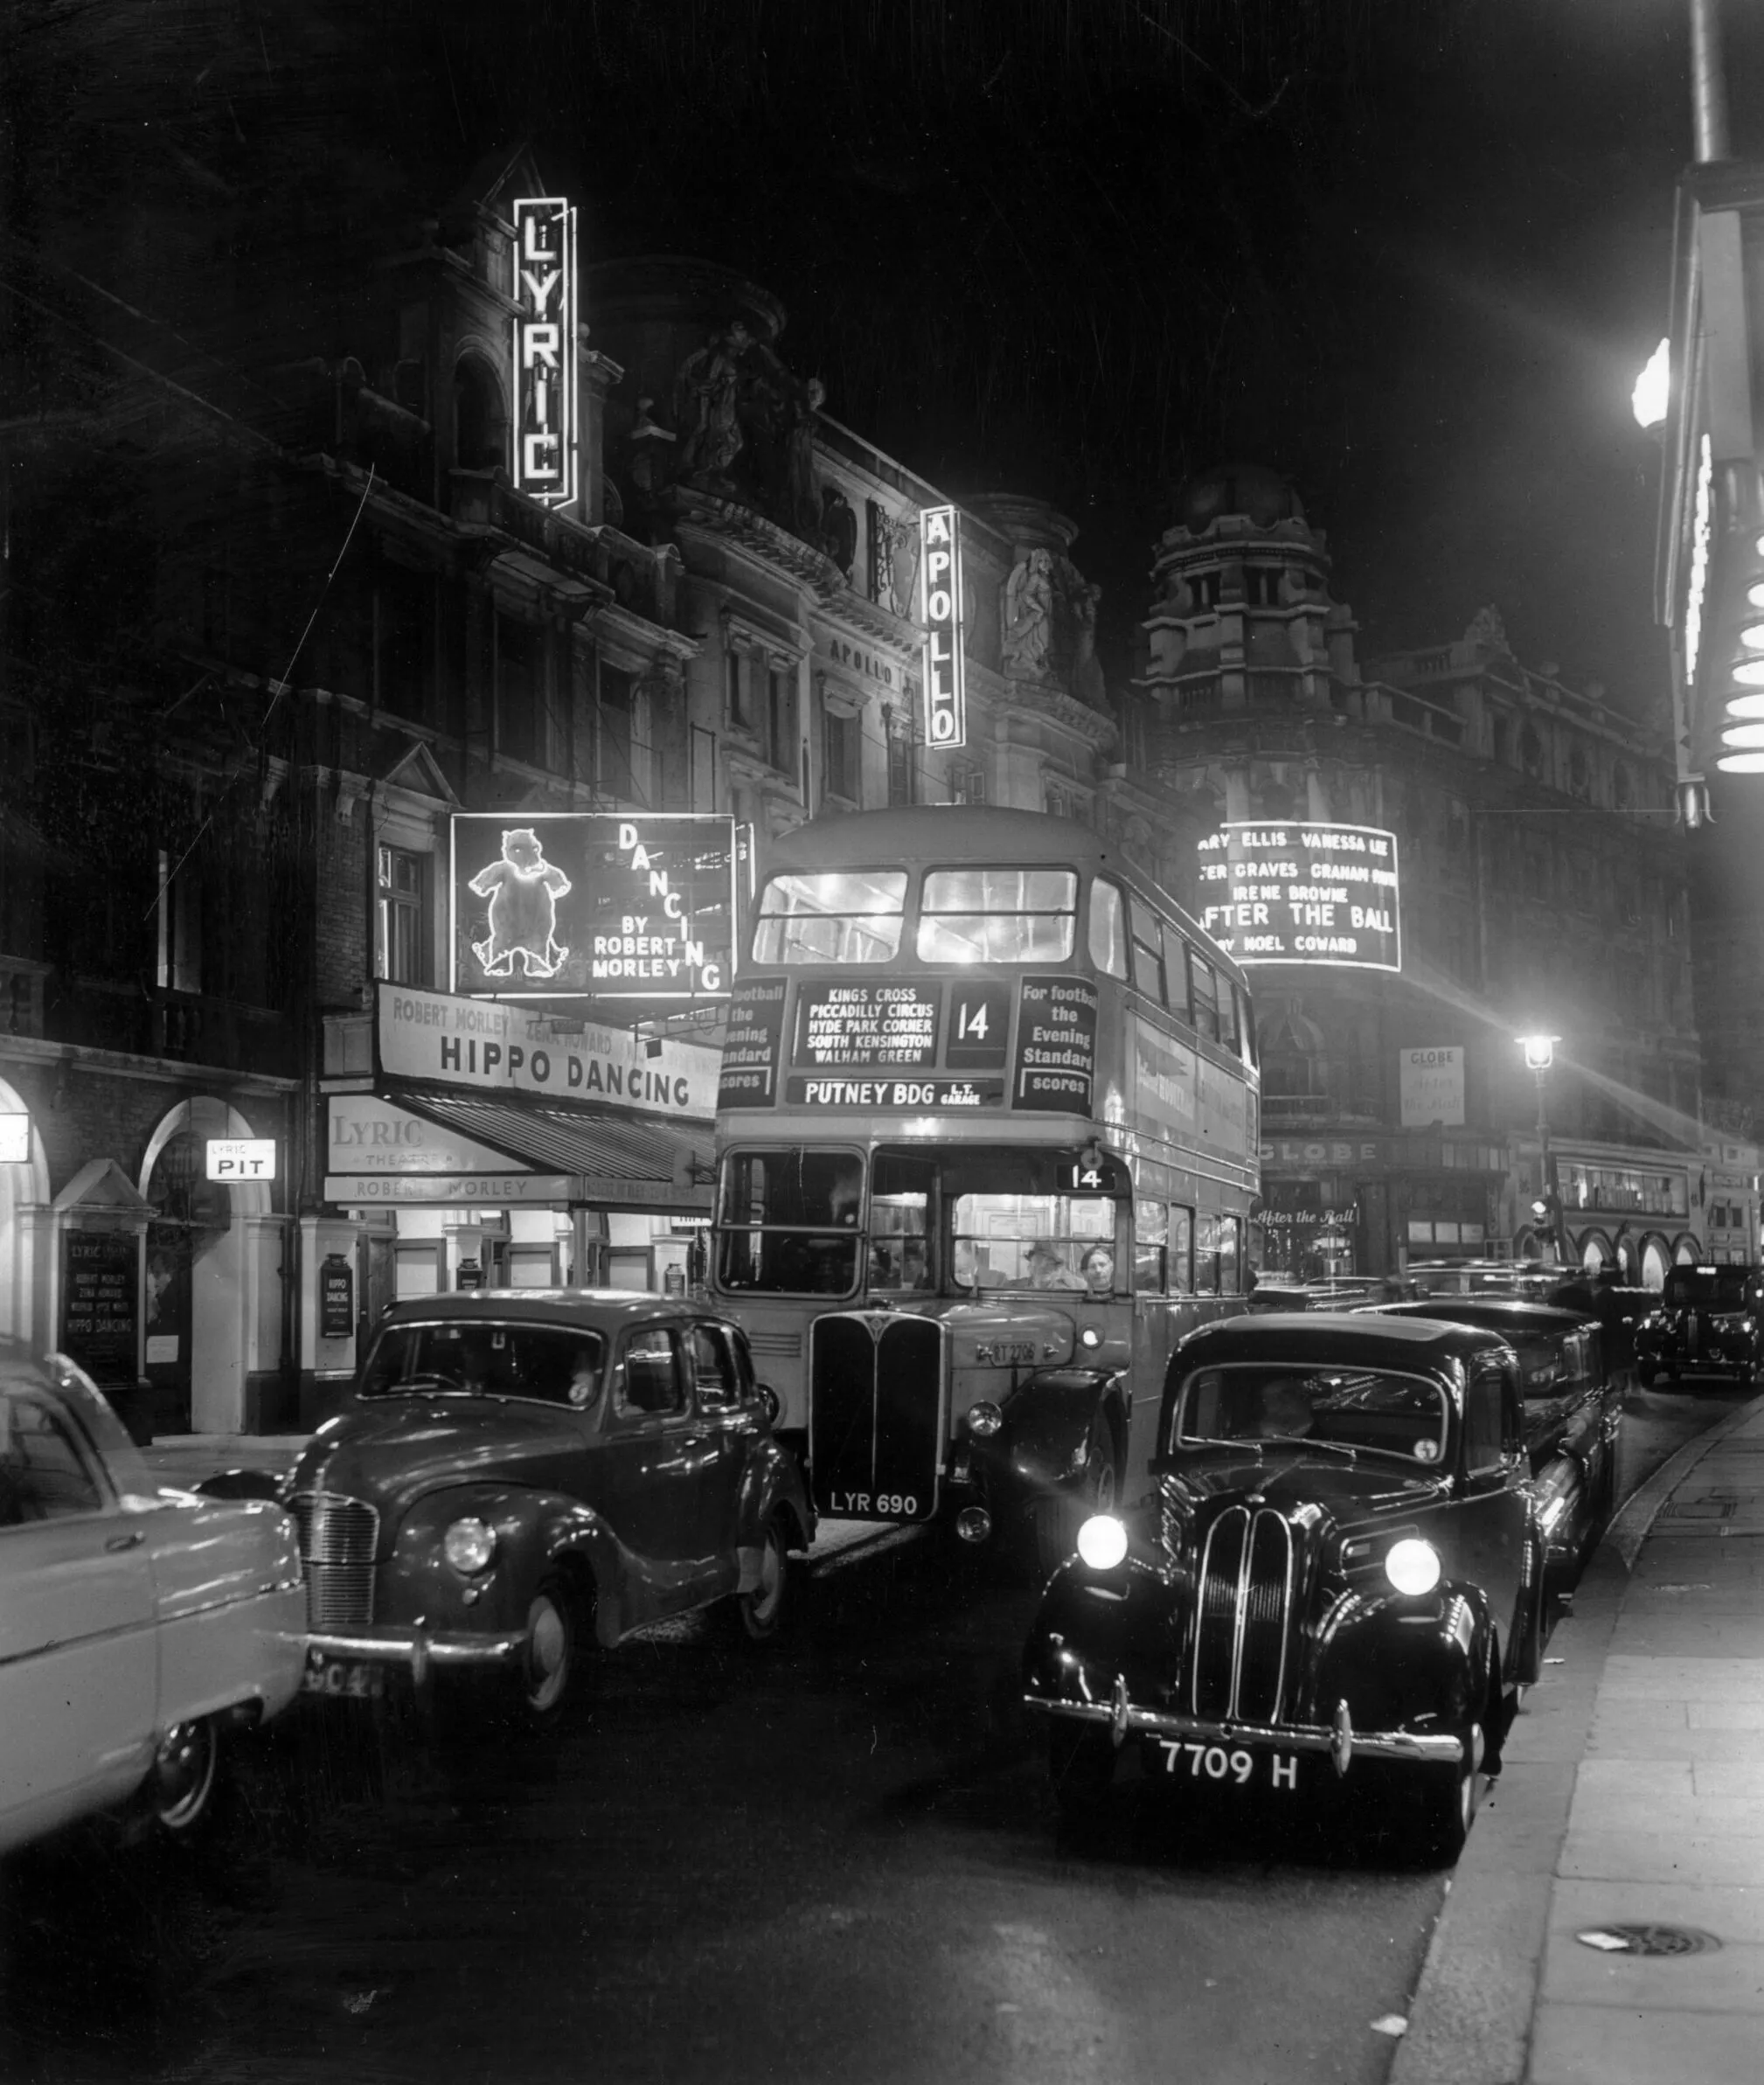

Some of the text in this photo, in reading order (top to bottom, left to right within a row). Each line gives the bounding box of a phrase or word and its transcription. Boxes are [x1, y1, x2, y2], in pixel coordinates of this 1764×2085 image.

[520, 215, 560, 479] LYRIC
[927, 513, 955, 740] APOLLO
[830, 639, 892, 685] APOLLO
[1241, 832, 1287, 847] ELLIS
[1302, 833, 1365, 851] VANESSA
[1369, 839, 1388, 857] LEE
[1234, 863, 1298, 878] GRAVES
[1310, 864, 1369, 882] GRAHAM
[1233, 885, 1348, 903] IRENE BROWNE
[619, 824, 719, 990] DANCING
[622, 916, 649, 934] BY
[1288, 903, 1335, 927] THE
[1350, 906, 1393, 933] BALL
[594, 936, 676, 956] ROBERT
[1244, 935, 1284, 951] NOEL
[1295, 936, 1357, 953] COWARD
[593, 959, 680, 977] MORLEY
[829, 988, 916, 1003] KINGS CROSS
[1023, 984, 1047, 1001] For
[393, 997, 448, 1028] ROBERT
[455, 1007, 510, 1038] MORLEY
[732, 1007, 754, 1022] the
[809, 1003, 934, 1018] PICCADILLY CIRCUS
[1052, 1006, 1078, 1023] the
[809, 1018, 933, 1033] HYDE PARK CORNER
[957, 1003, 989, 1039] 14
[807, 1034, 933, 1048] SOUTH KENSINGTON
[1032, 1026, 1090, 1050] Evening
[815, 1049, 922, 1063] WALHAM GREEN
[1411, 1051, 1453, 1065] GLOBE
[441, 1035, 550, 1082] HIPPO
[568, 1055, 689, 1107] DANCING
[805, 1082, 934, 1104] PUTNEY BDG
[951, 1084, 974, 1095] L.T.
[1032, 1077, 1085, 1095] scores
[941, 1095, 981, 1105] GARAGE
[332, 1115, 423, 1148] LYRIC
[1260, 1143, 1376, 1161] GLOBE
[218, 1159, 264, 1175] PIT
[1073, 1165, 1101, 1189] 14
[448, 1180, 527, 1197] MORLEY
[1257, 1209, 1293, 1227] After
[1296, 1209, 1316, 1224] the
[830, 1491, 917, 1514] LYR 690
[1159, 1740, 1297, 1790] 7709 H
